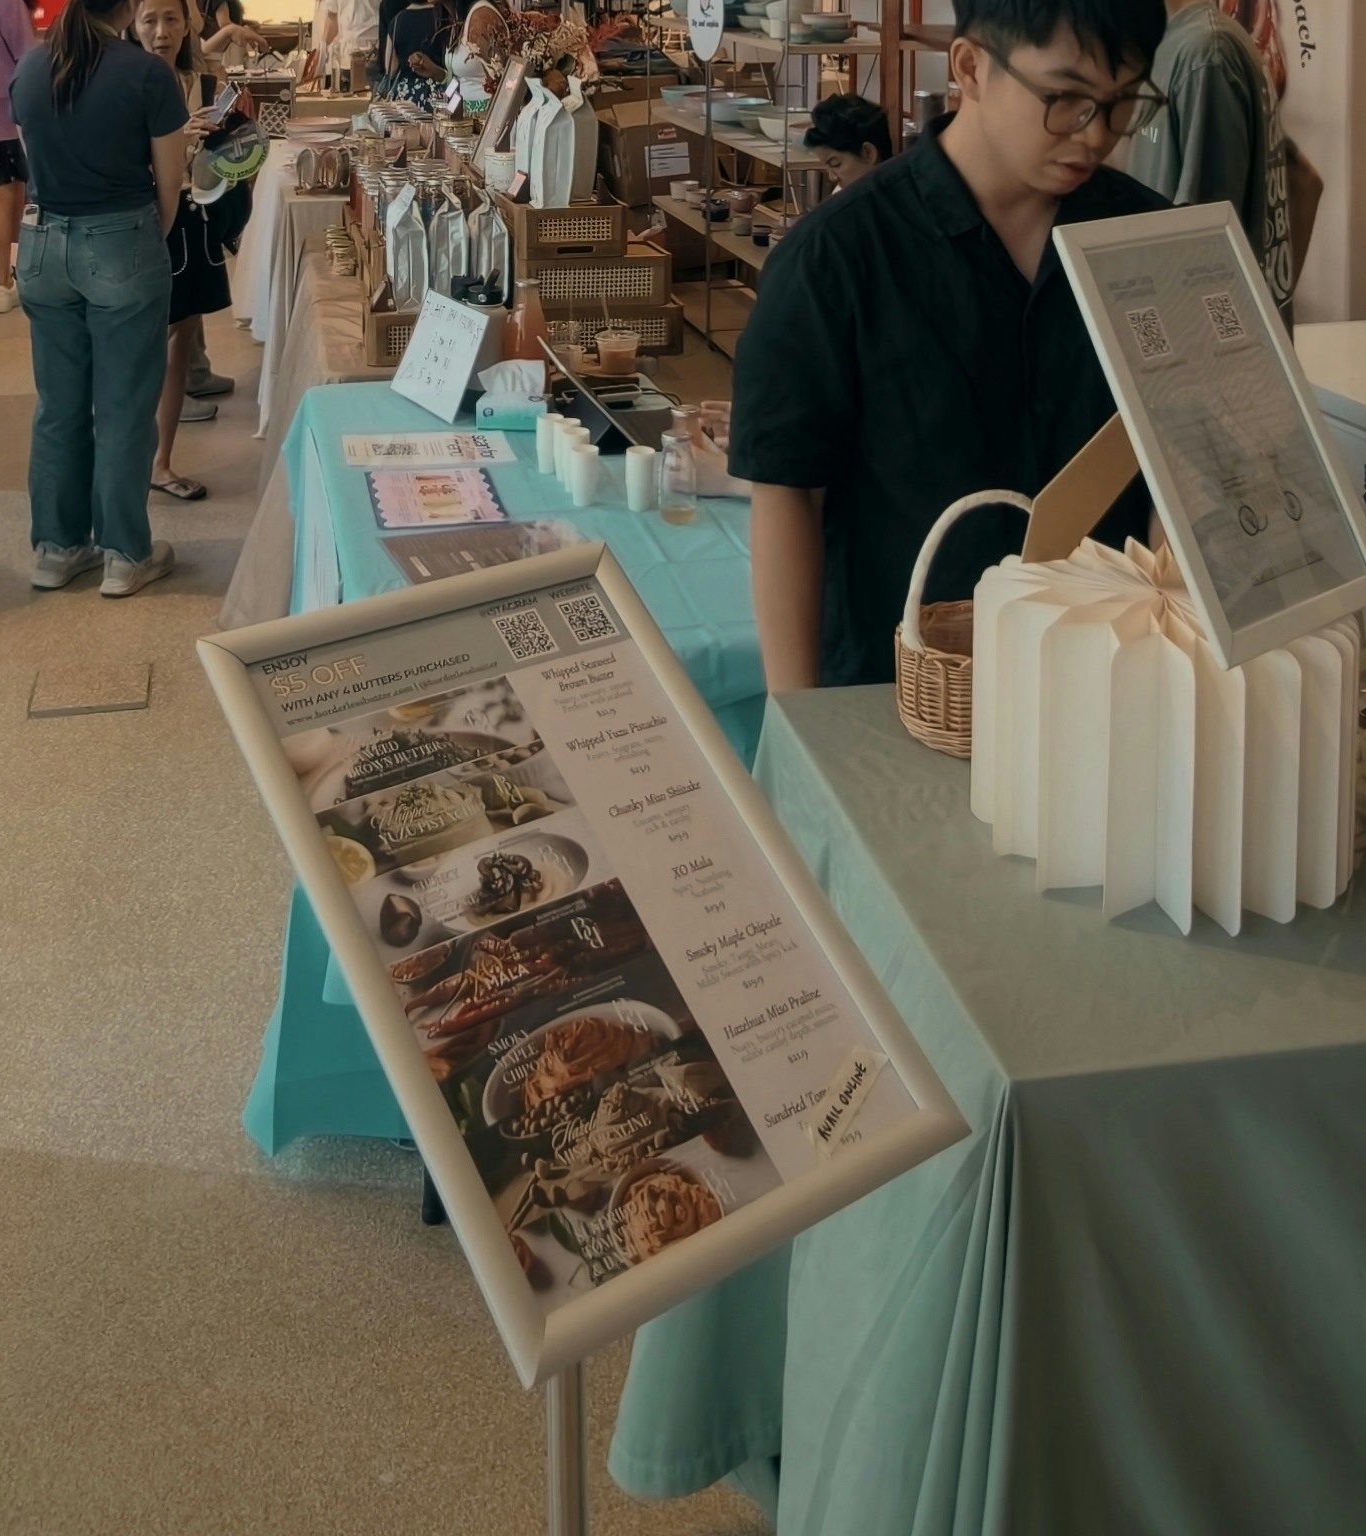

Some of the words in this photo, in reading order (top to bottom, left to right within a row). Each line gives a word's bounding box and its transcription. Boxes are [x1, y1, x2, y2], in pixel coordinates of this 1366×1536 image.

[547, 583, 594, 601] WEBSITE
[478, 596, 540, 617] INSTAGRAM
[262, 653, 309, 675] ENJOY
[269, 669, 309, 700] $5
[310, 653, 367, 685] OFF
[541, 661, 580, 681] Whipped
[281, 693, 315, 713] WITH
[315, 688, 340, 707] ANY
[342, 685, 352, 698] 4
[353, 672, 403, 695] BUTTERS
[404, 652, 471, 679] PURCHASED
[565, 731, 605, 753] Whipped
[629, 713, 669, 735] Pistachio
[346, 753, 395, 779] BROWN
[608, 798, 645, 818] Chunky
[645, 792, 667, 808] Miso
[671, 864, 689, 880] XO
[689, 855, 714, 873] Mala
[685, 940, 718, 963] Smoky
[717, 928, 747, 949] Maple
[745, 913, 783, 938] Chipotle
[484, 962, 530, 991] MALA
[723, 1013, 766, 1041] Hazelnut
[765, 1001, 789, 1022] Miso
[788, 988, 822, 1010] Praline
[487, 1028, 530, 1056] SMOKY
[763, 1094, 807, 1129] Sundried
[816, 1104, 844, 1143] AVAIL
[838, 1060, 867, 1107] ONLINE
